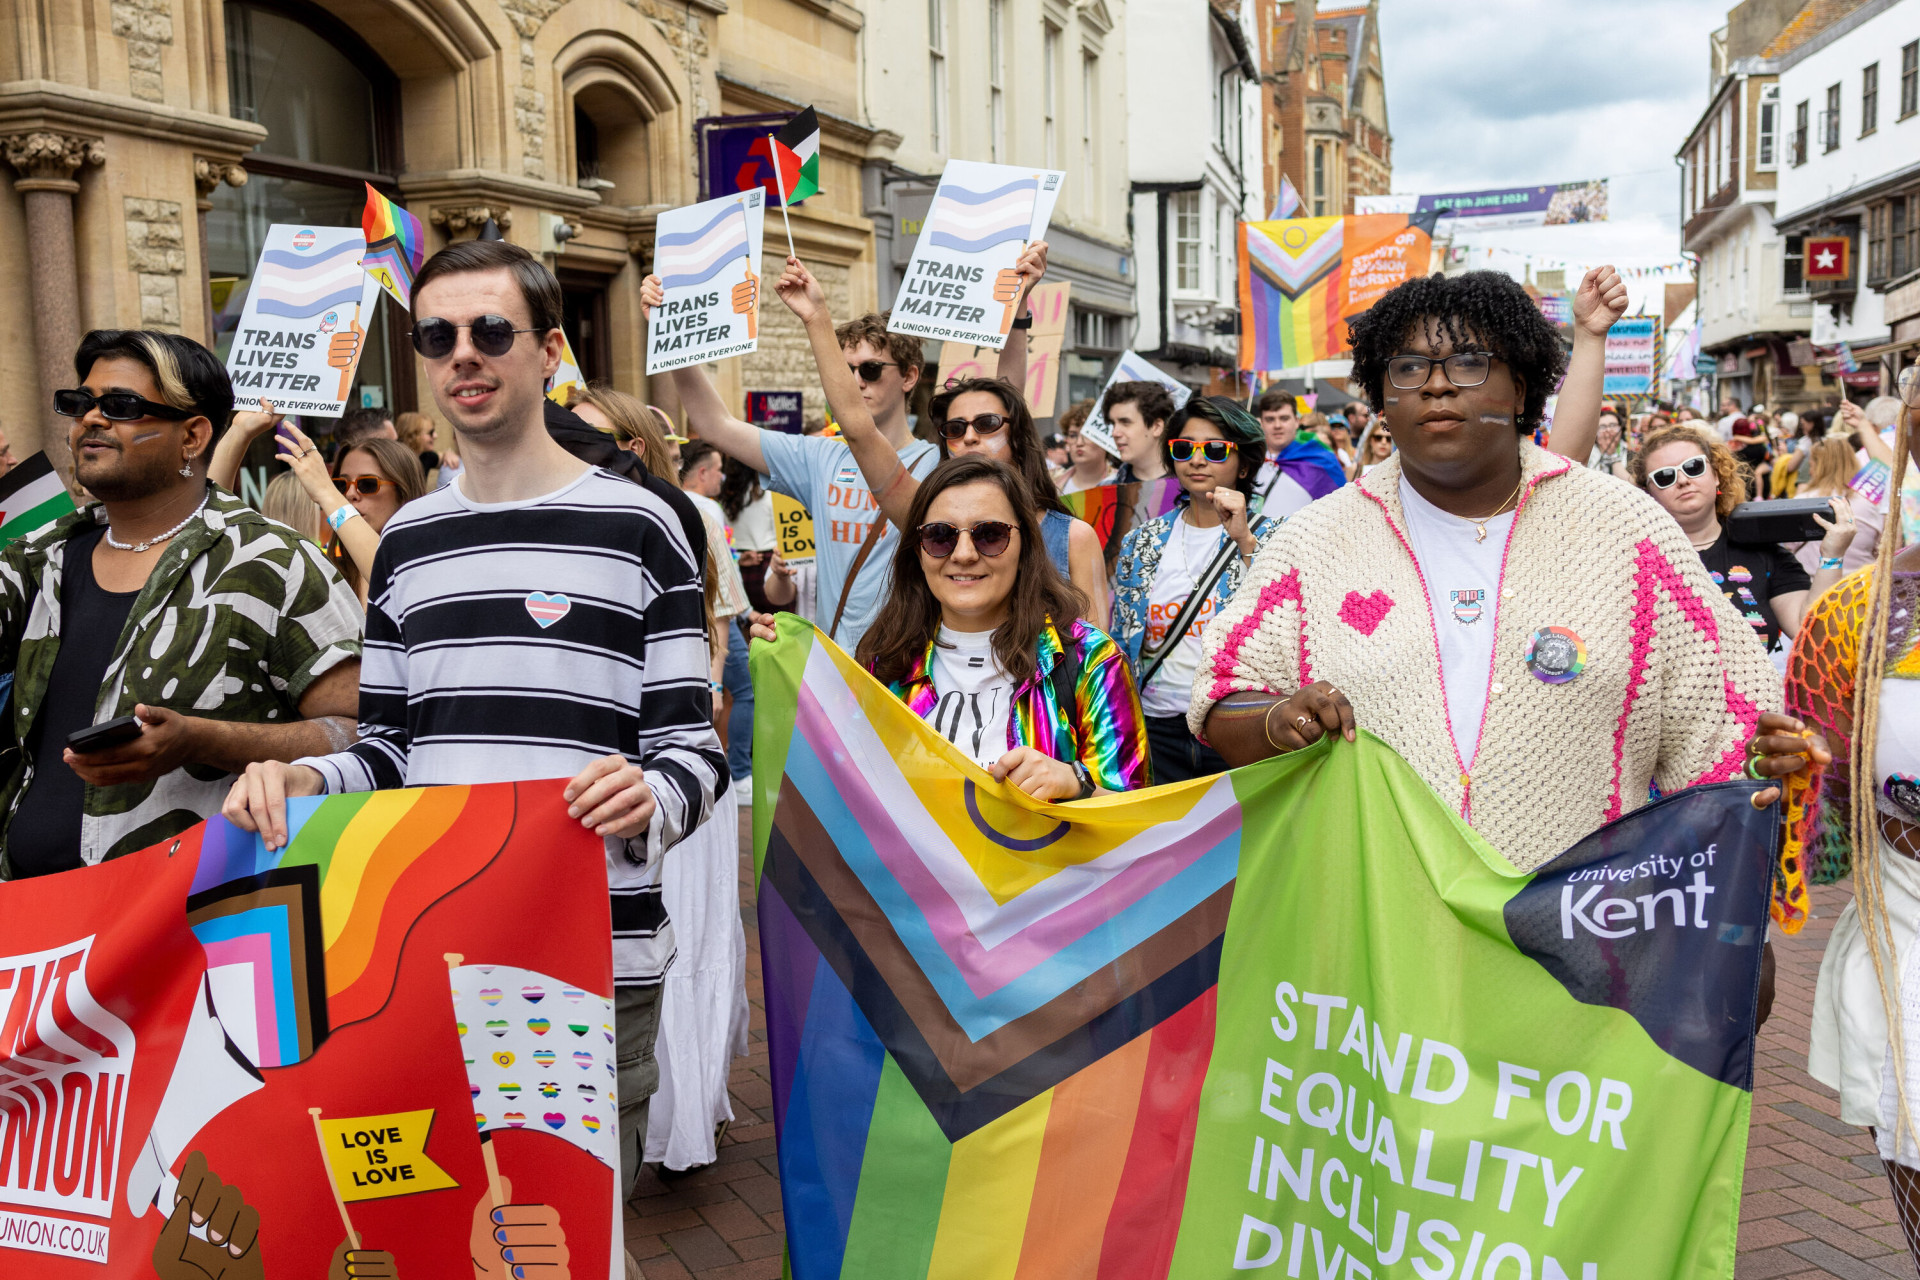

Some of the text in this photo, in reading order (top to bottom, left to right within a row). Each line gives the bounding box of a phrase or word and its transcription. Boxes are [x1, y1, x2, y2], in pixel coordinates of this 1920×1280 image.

[916, 259, 984, 283] TRANS
[907, 278, 967, 301] LIVES
[656, 291, 719, 318] TRANS
[899, 297, 985, 324] MATTER
[655, 311, 708, 337] LIVES
[893, 321, 1003, 344] A UNION FOR EVERYONE
[243, 328, 317, 350] TRANS
[653, 324, 731, 355] MATTER
[235, 349, 299, 369] LIVES
[652, 341, 753, 370] A UNION FOR EVERYONE
[231, 369, 321, 392] MATTER
[287, 401, 341, 412] EVERYONE
[778, 509, 813, 525] LOV
[782, 525, 799, 539] IS
[783, 538, 816, 554] LOV
[1450, 589, 1485, 602] PRIDE
[1567, 843, 1718, 883] University of
[1560, 870, 1716, 940] Kent
[1270, 980, 1633, 1151] STAND FOR
[0, 1071, 125, 1202] NION
[341, 1127, 403, 1149] LOVE
[1259, 1056, 1585, 1228] EQUALITY
[365, 1148, 388, 1165] IS
[352, 1164, 416, 1187] LOVE
